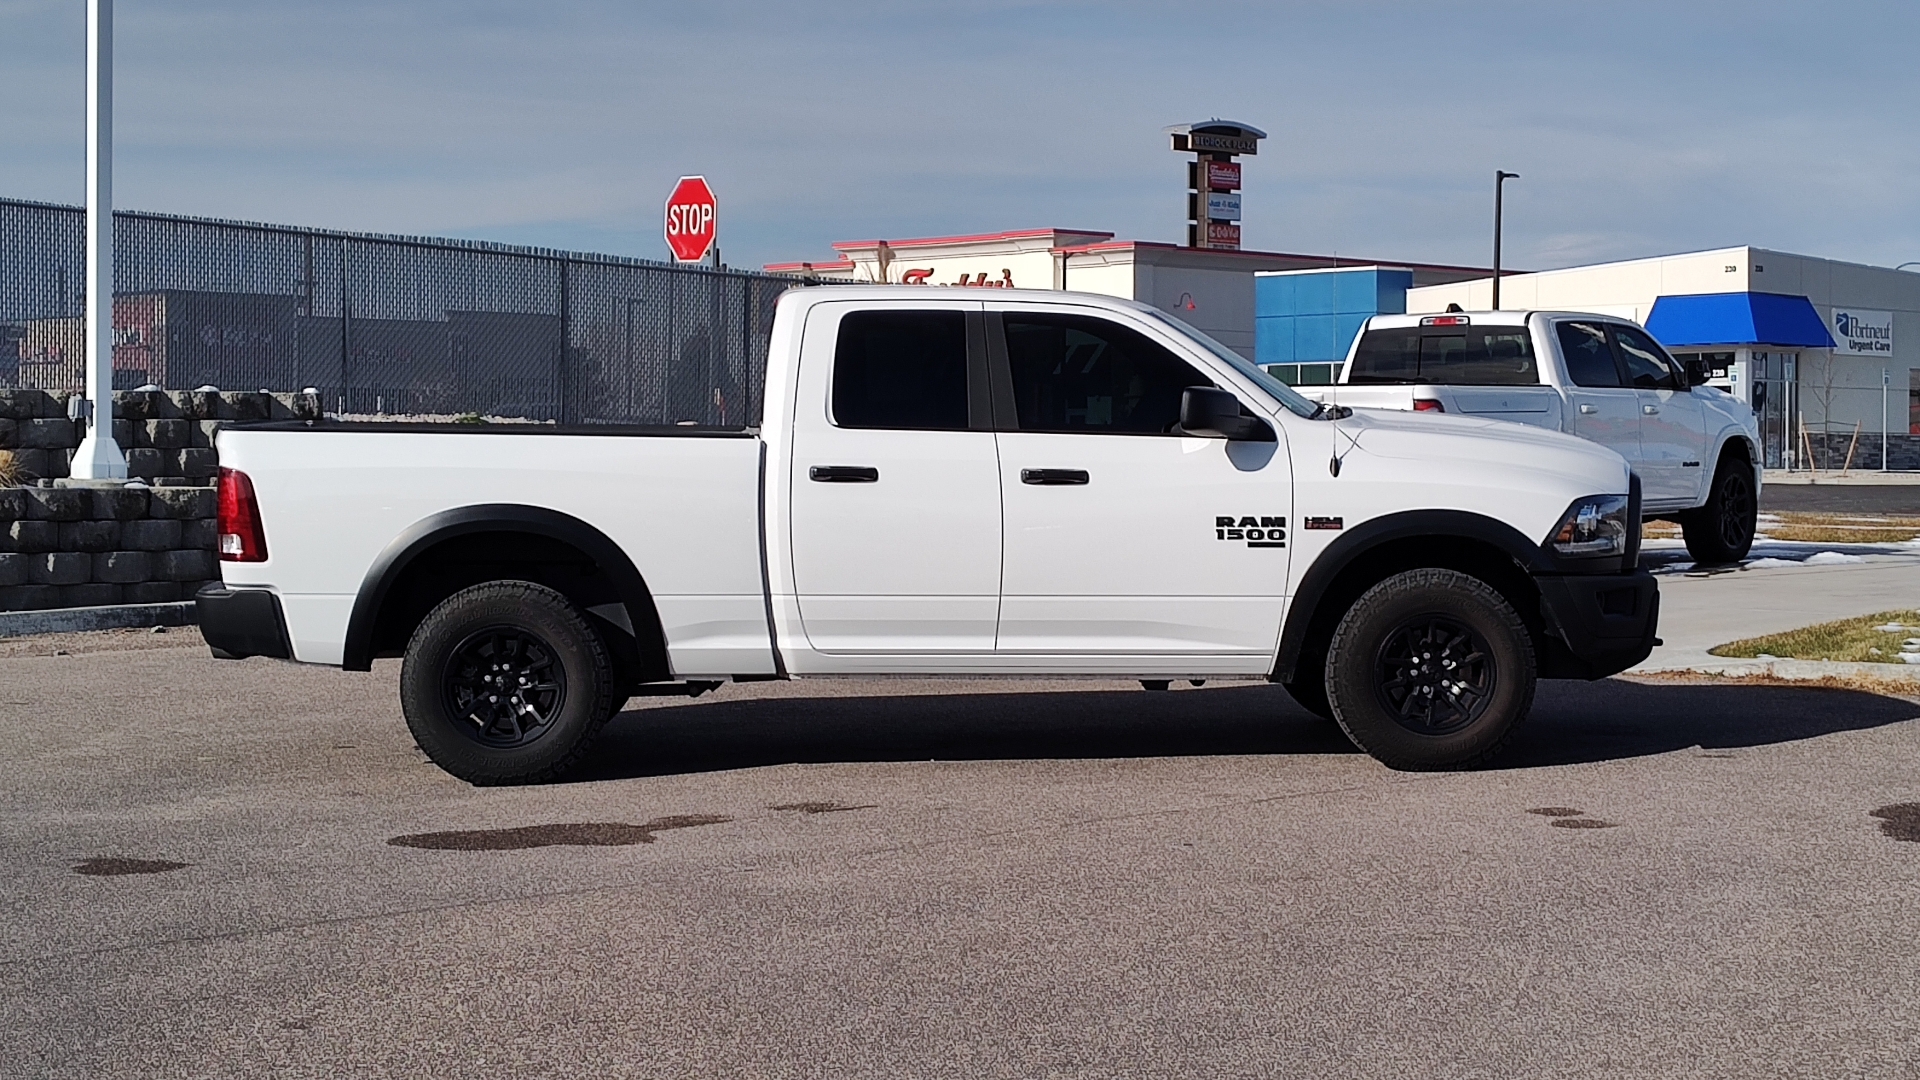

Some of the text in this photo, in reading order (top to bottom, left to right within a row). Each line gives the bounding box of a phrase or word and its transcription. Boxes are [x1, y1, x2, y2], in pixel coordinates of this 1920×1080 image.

[1232, 140, 1256, 150] PLAZA
[668, 203, 713, 236] STOP
[1849, 316, 1890, 340] Portneuf
[1849, 339, 1890, 352] Urgent Care
[1216, 516, 1286, 528] RAM
[1216, 529, 1286, 540] 1500
